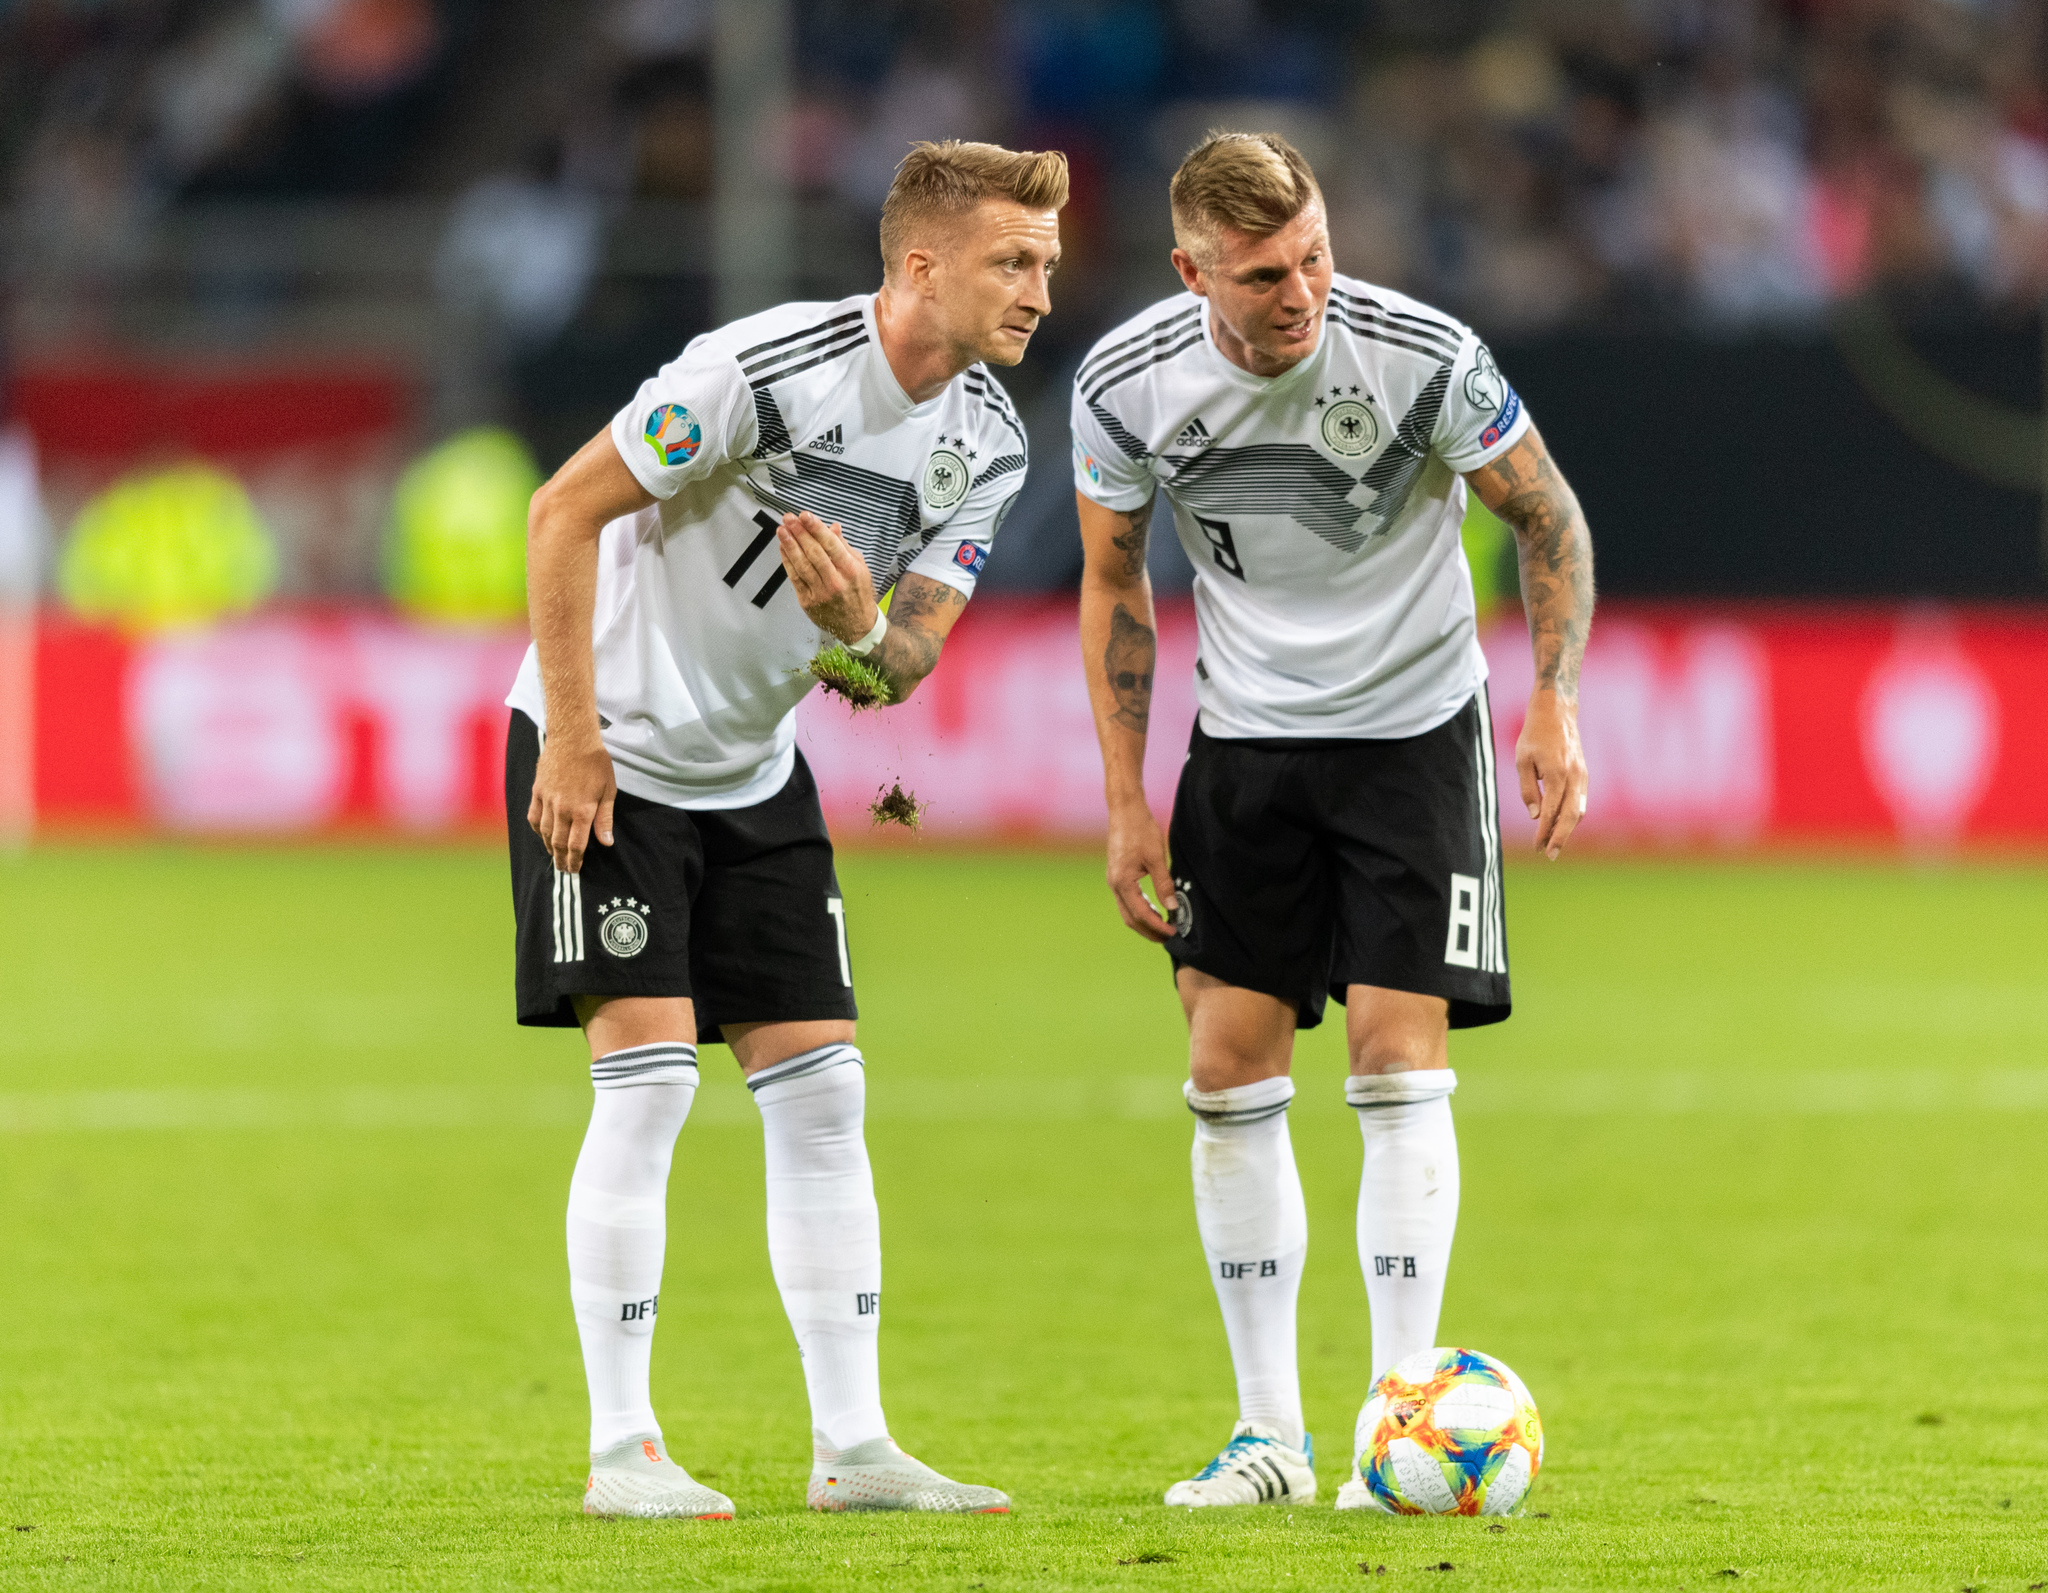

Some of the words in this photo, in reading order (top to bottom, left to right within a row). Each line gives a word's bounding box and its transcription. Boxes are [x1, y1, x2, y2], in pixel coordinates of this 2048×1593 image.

[1497, 388, 1518, 432] RESPEC
[808, 440, 845, 455] adidas
[1444, 872, 1480, 970] 8
[827, 898, 852, 987] 1
[1220, 1260, 1276, 1279] DFB
[1374, 1256, 1416, 1278] DFB
[856, 1292, 880, 1315] DF
